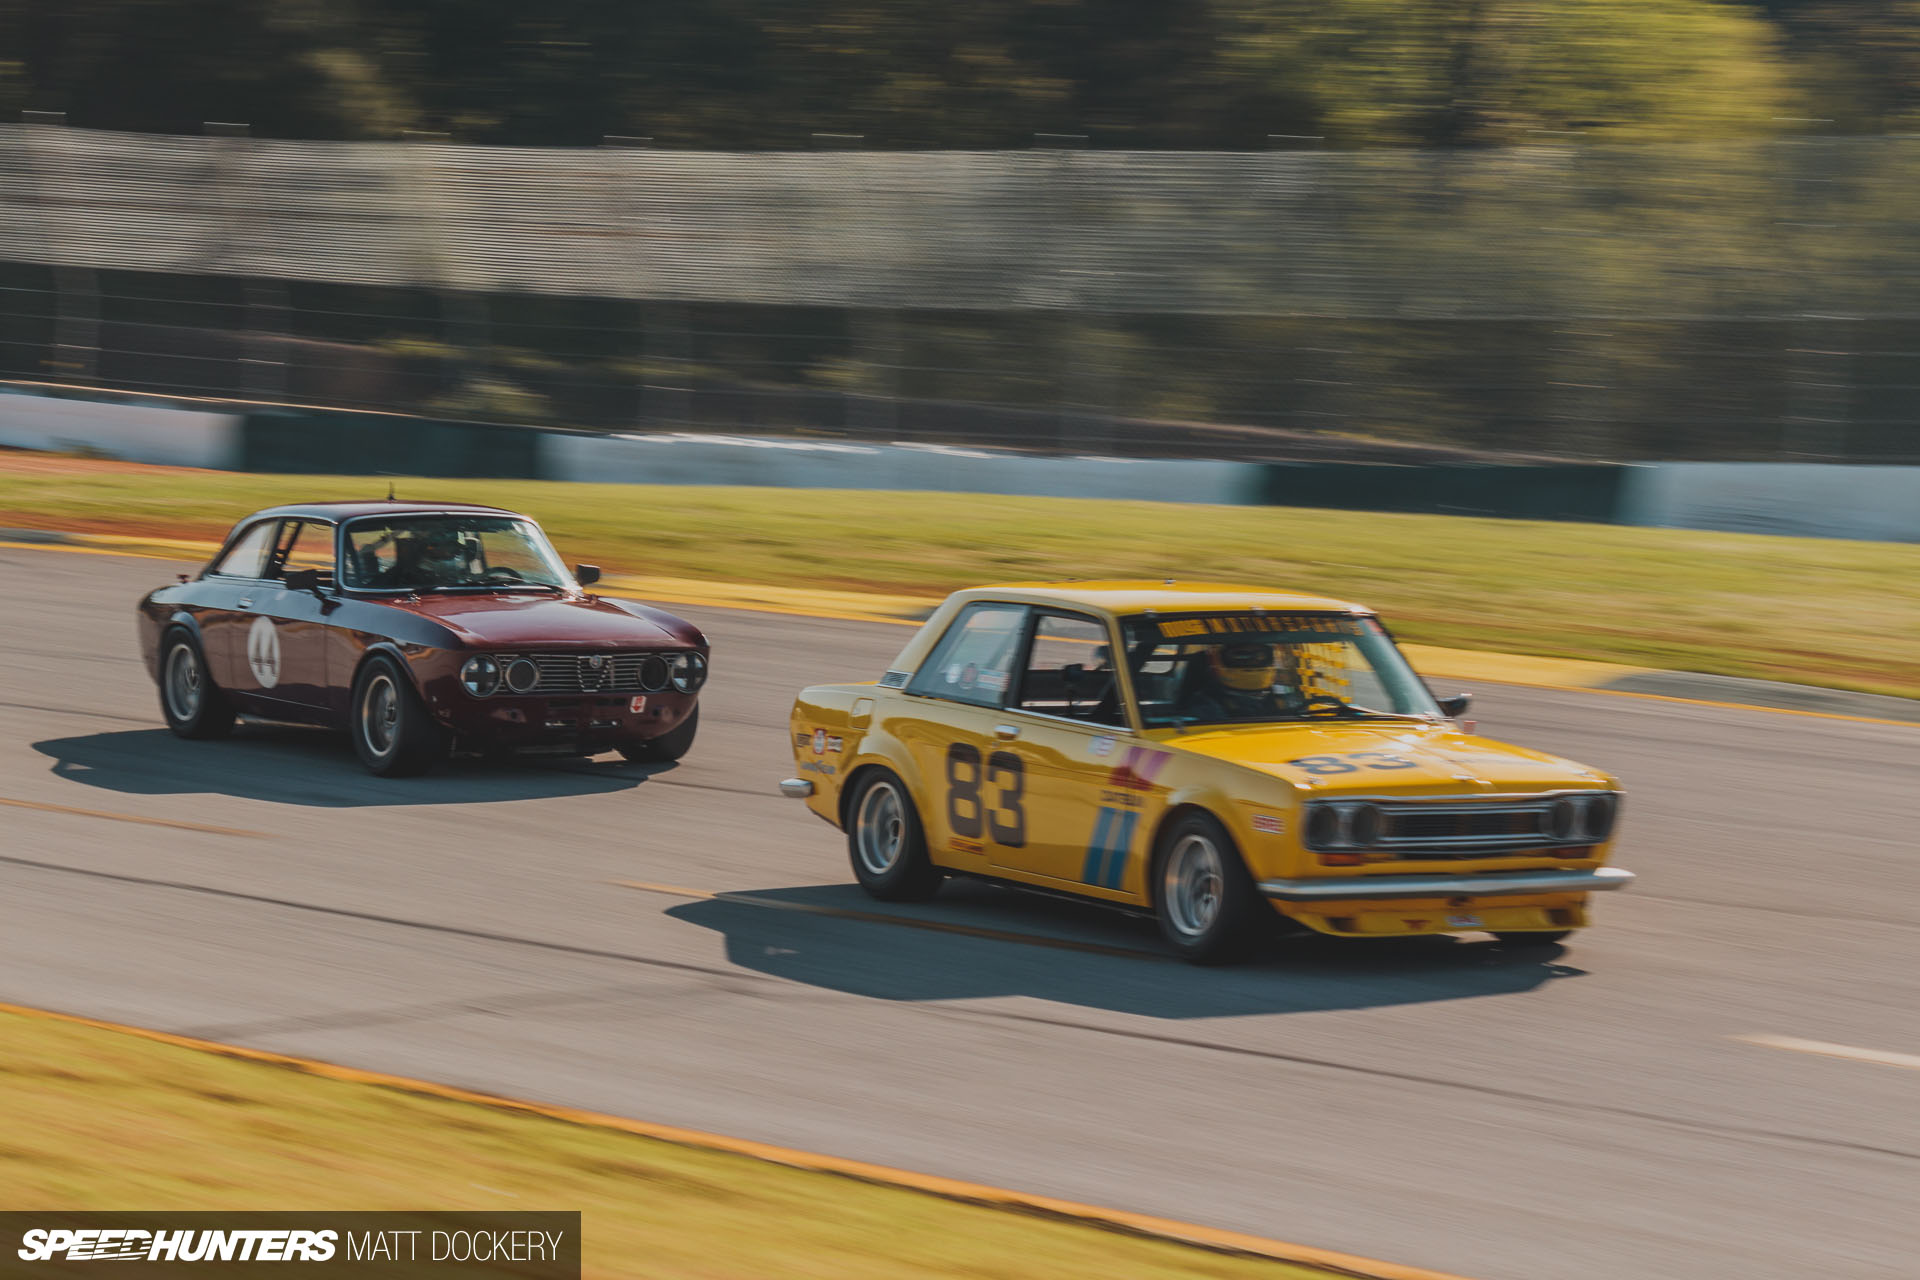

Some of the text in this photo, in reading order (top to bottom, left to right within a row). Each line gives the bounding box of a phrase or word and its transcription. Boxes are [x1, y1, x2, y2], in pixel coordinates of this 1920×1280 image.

[251, 628, 277, 676] 44
[1287, 753, 1418, 775] 83
[947, 742, 1026, 848] 83
